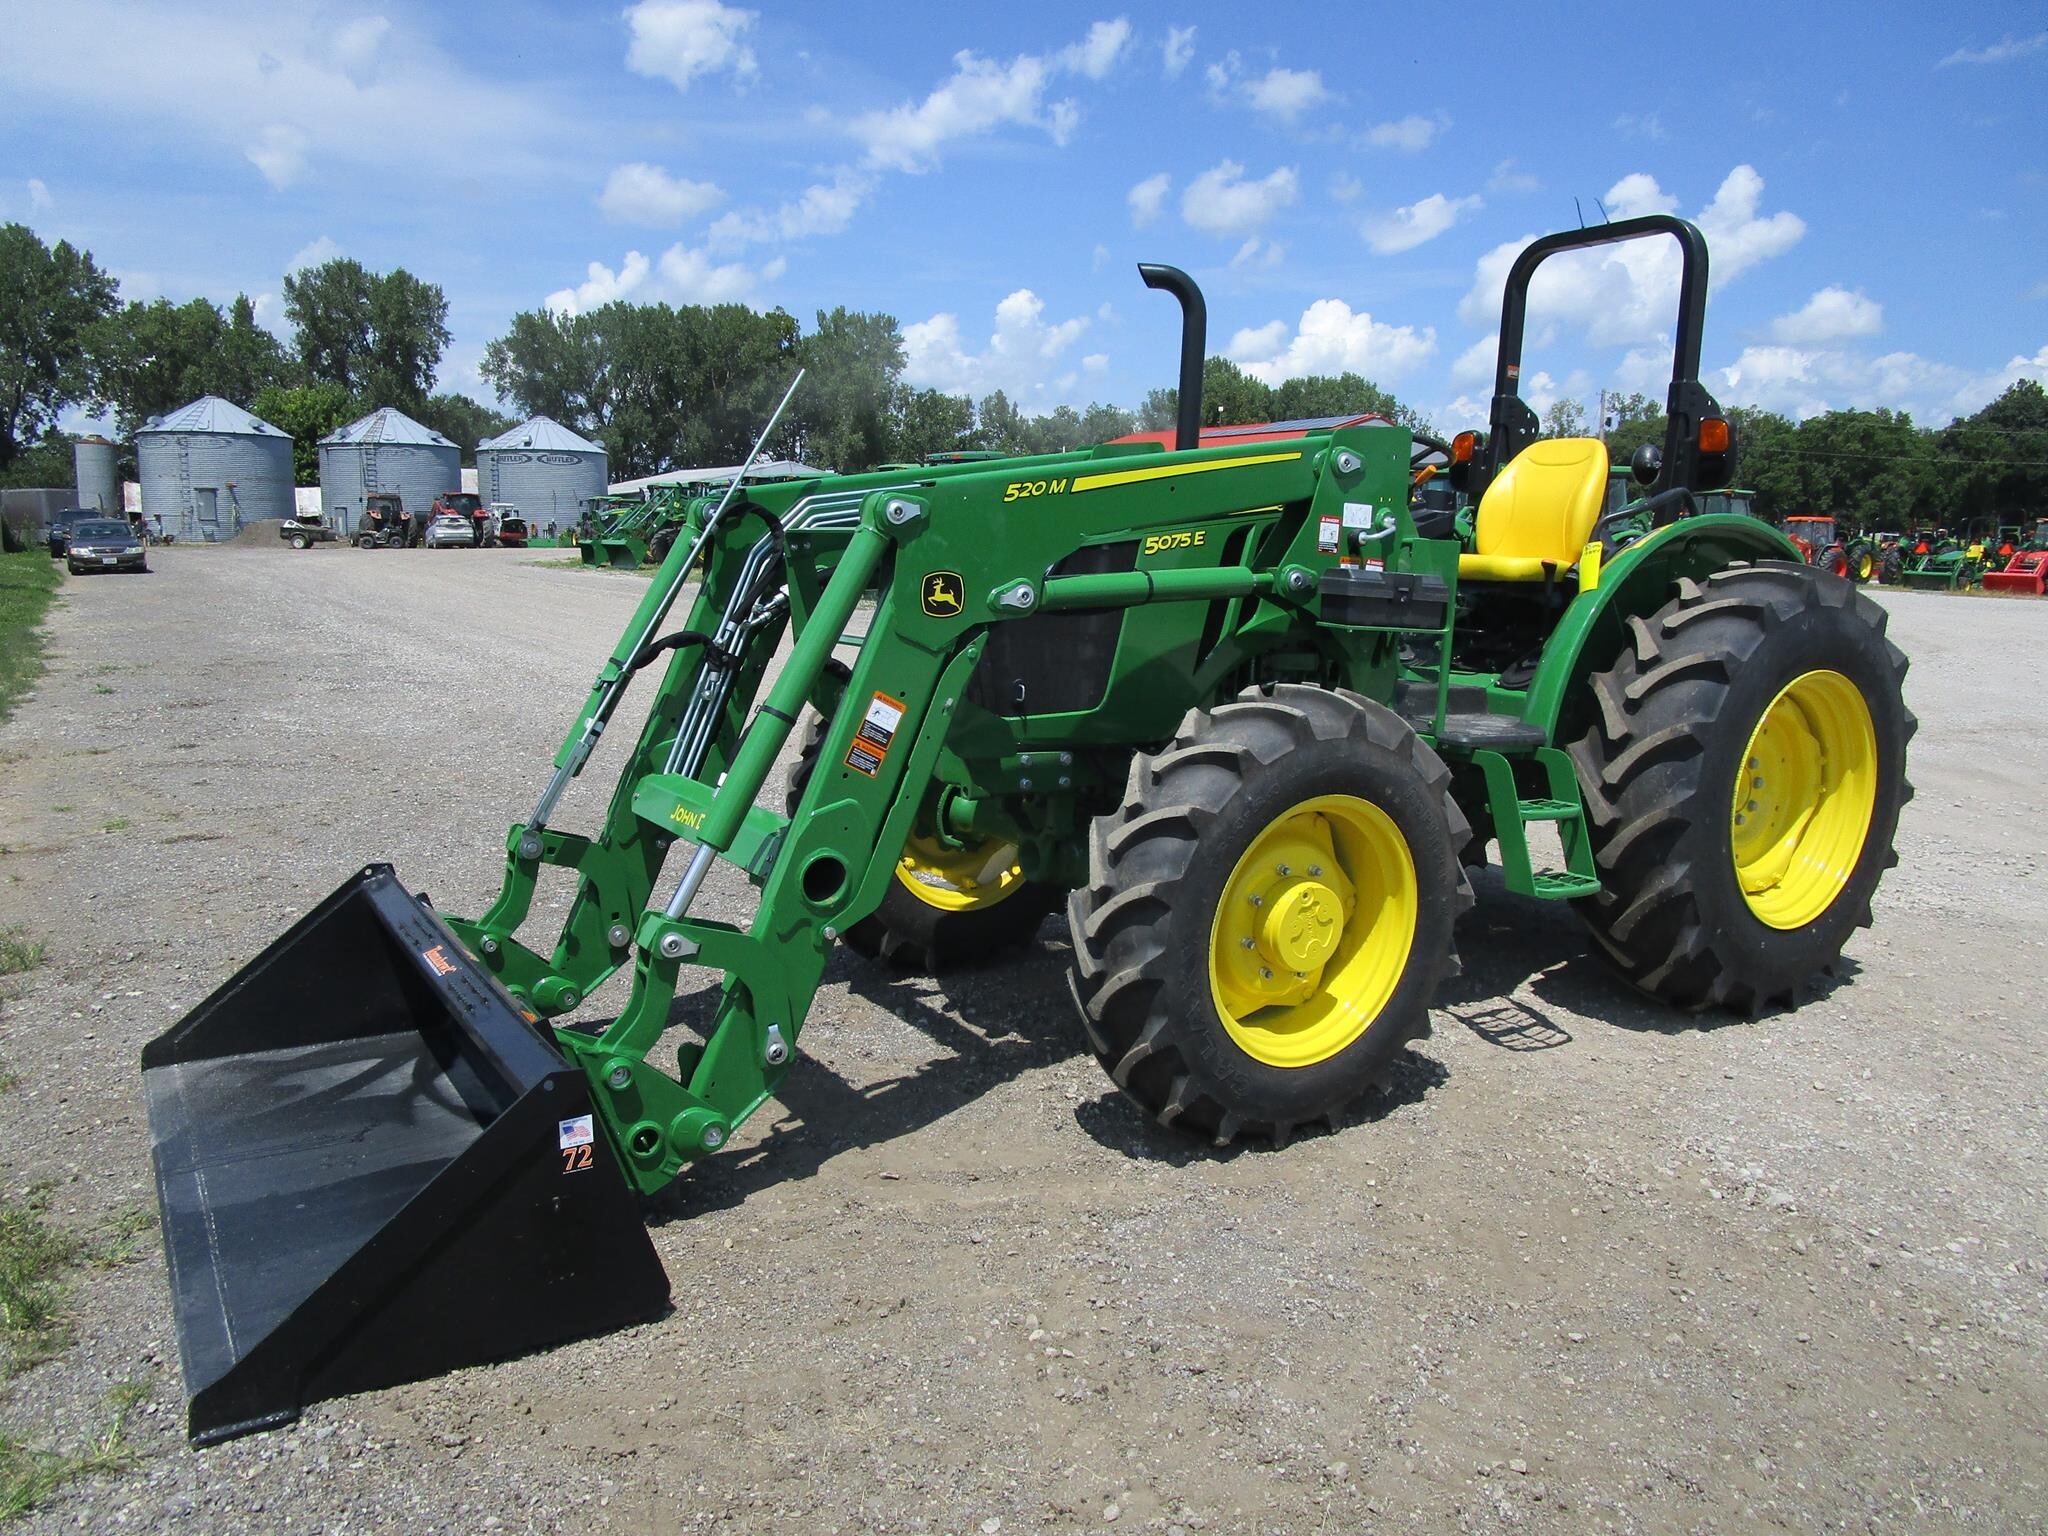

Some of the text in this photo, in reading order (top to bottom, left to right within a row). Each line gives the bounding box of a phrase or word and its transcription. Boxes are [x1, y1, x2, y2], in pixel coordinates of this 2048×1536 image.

[1004, 478, 1068, 502] 520 M
[1144, 531, 1206, 555] 5075 E
[670, 804, 698, 828] JOHN
[562, 1144, 593, 1171] 72
